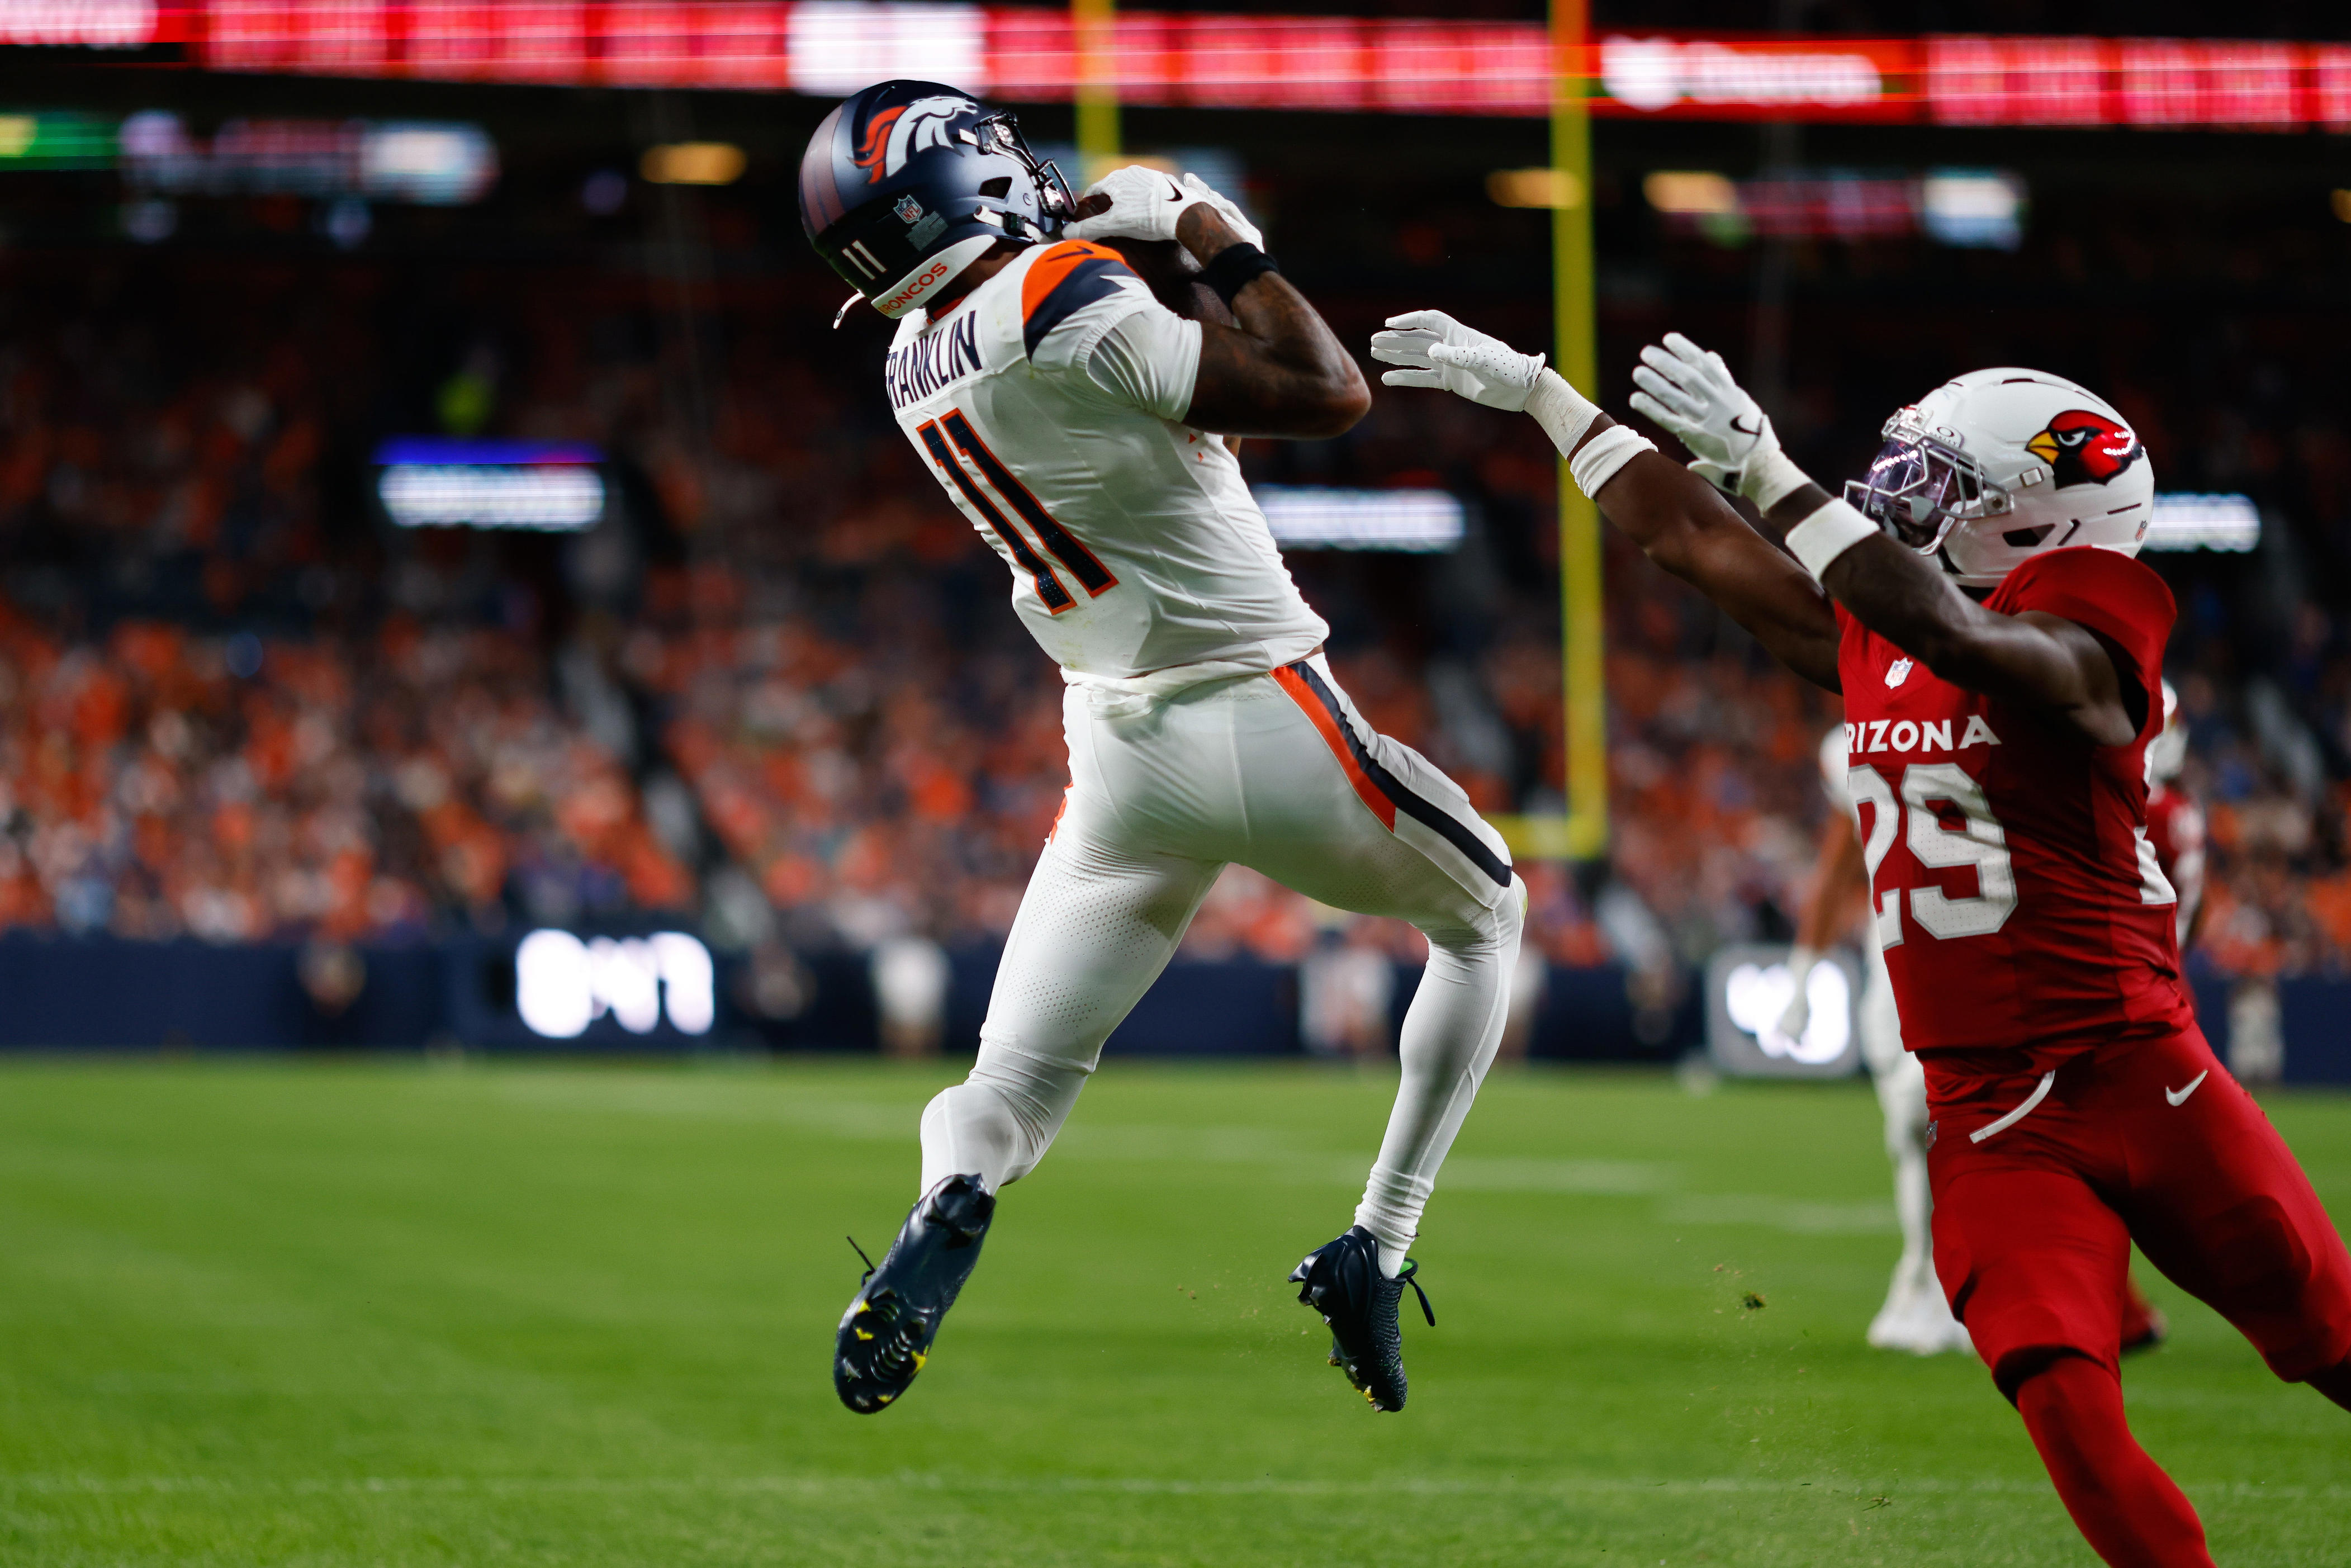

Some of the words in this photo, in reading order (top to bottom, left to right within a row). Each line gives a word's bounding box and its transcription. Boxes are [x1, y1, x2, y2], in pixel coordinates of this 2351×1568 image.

[903, 205, 919, 220] NFL
[842, 240, 887, 280] 11
[916, 408, 1119, 615] 11
[1844, 714, 2002, 754] RIZONA
[1847, 762, 2018, 950] 29
